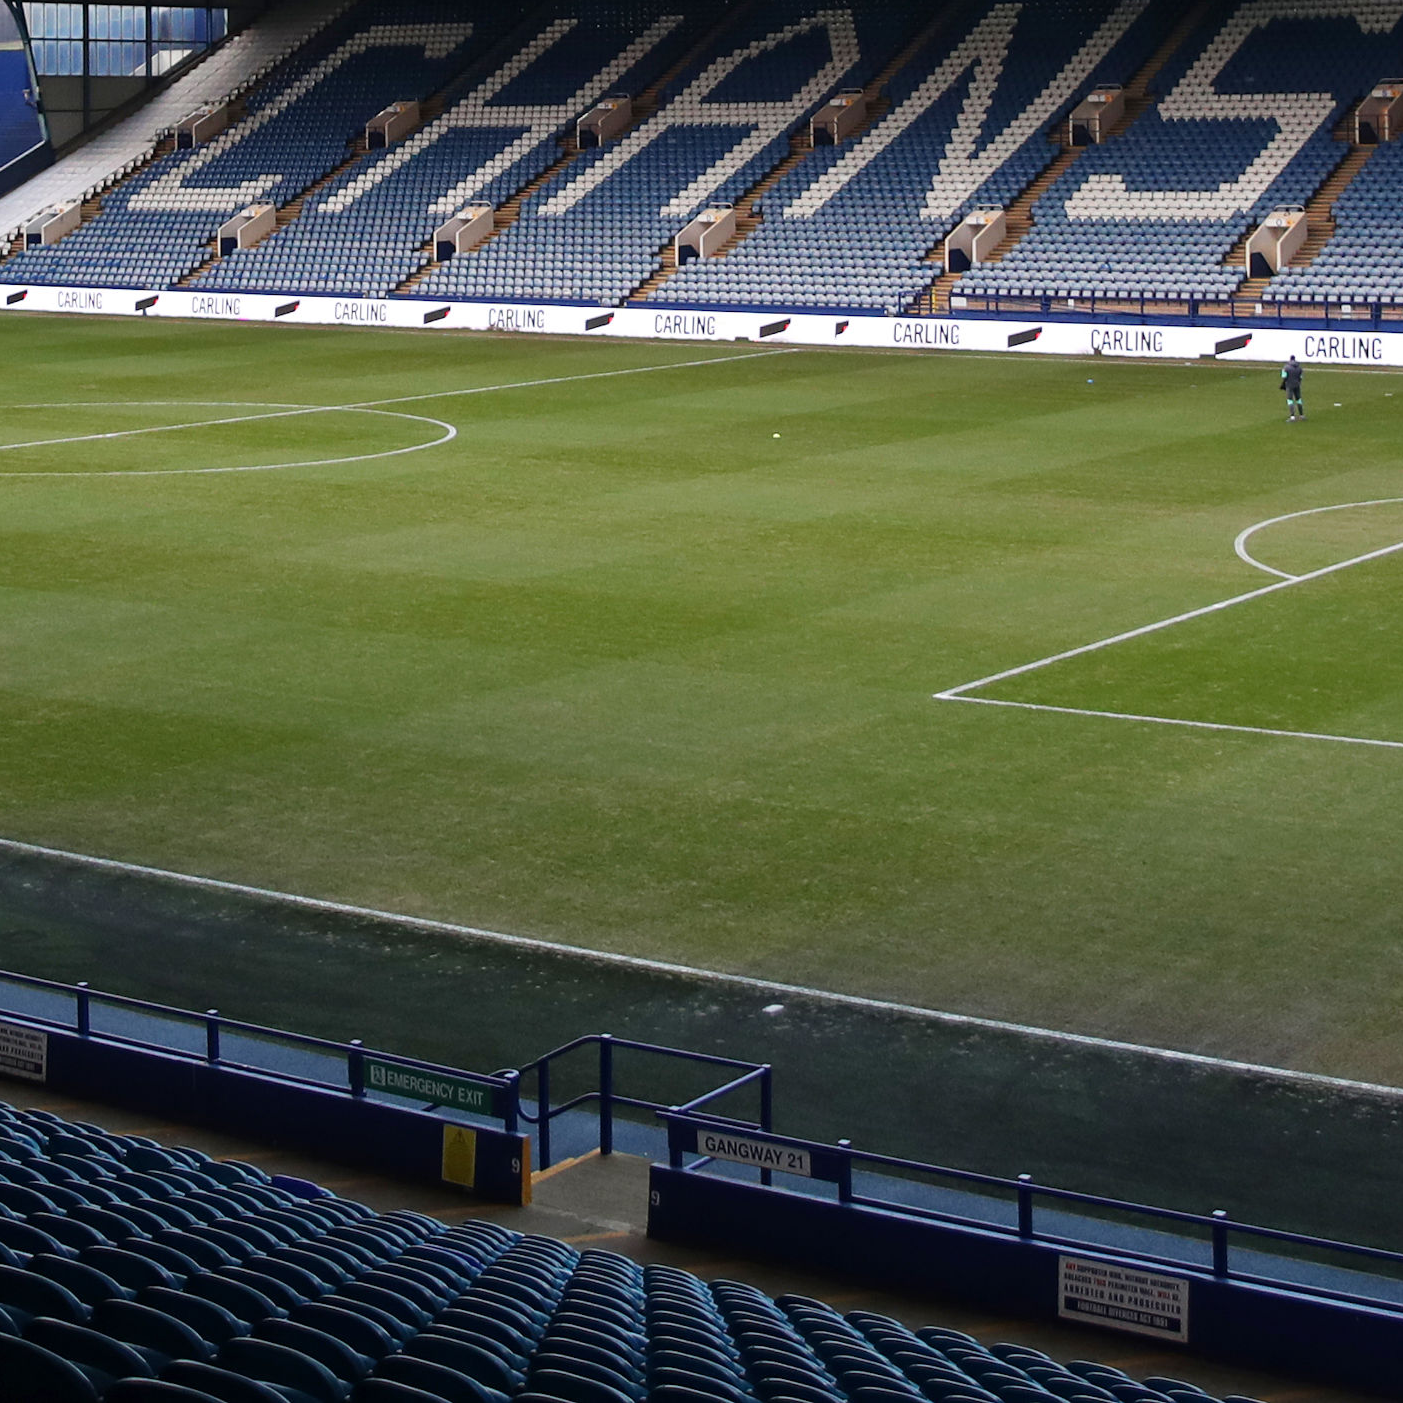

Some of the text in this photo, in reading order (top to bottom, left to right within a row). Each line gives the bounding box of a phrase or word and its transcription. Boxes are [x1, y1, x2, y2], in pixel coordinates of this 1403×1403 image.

[57, 292, 102, 309] CARLING
[192, 297, 240, 315] CARLING
[334, 303, 386, 322] CARLING
[488, 309, 544, 329] CARLING
[654, 314, 715, 335] CARLING
[893, 323, 959, 345] CARLING
[1090, 329, 1163, 352] CARLING
[1304, 336, 1382, 361] CARLING
[387, 1071, 484, 1106] EMERGENCY EXIT
[705, 1136, 804, 1169] GANGWAY 21
[512, 1157, 521, 1173] 9
[651, 1190, 660, 1206] 9
[1064, 1283, 1181, 1315] ARRESTED AND PROSECUTED
